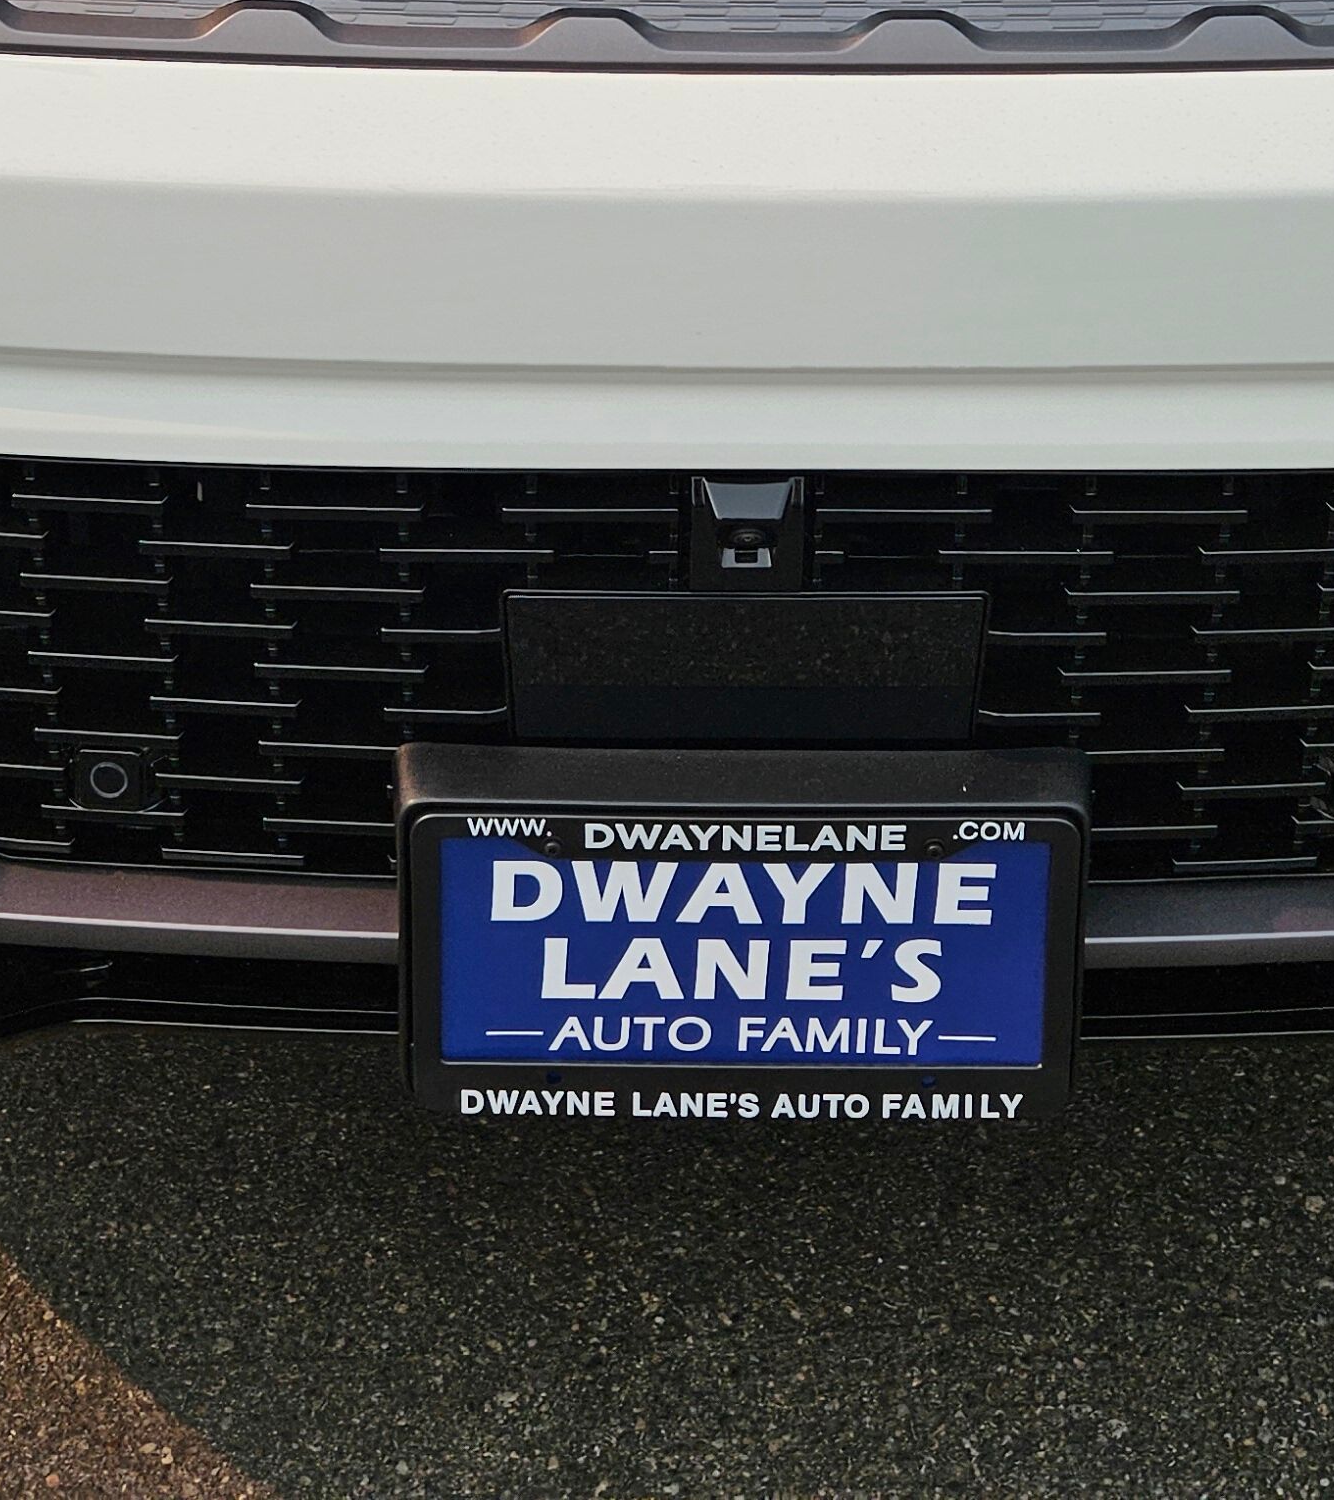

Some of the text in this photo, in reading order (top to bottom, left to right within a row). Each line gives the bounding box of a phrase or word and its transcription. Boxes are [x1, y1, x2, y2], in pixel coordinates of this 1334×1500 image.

[584, 823, 907, 852] DWAYNELANE
[953, 821, 1026, 842] .COM
[490, 860, 997, 925] DWAYNE
[541, 937, 943, 1003] LANE'S
[548, 1016, 934, 1056] AUTO FAMILY
[460, 1089, 1024, 1120] DWAYNE LANE'S AUTO FAMILY
